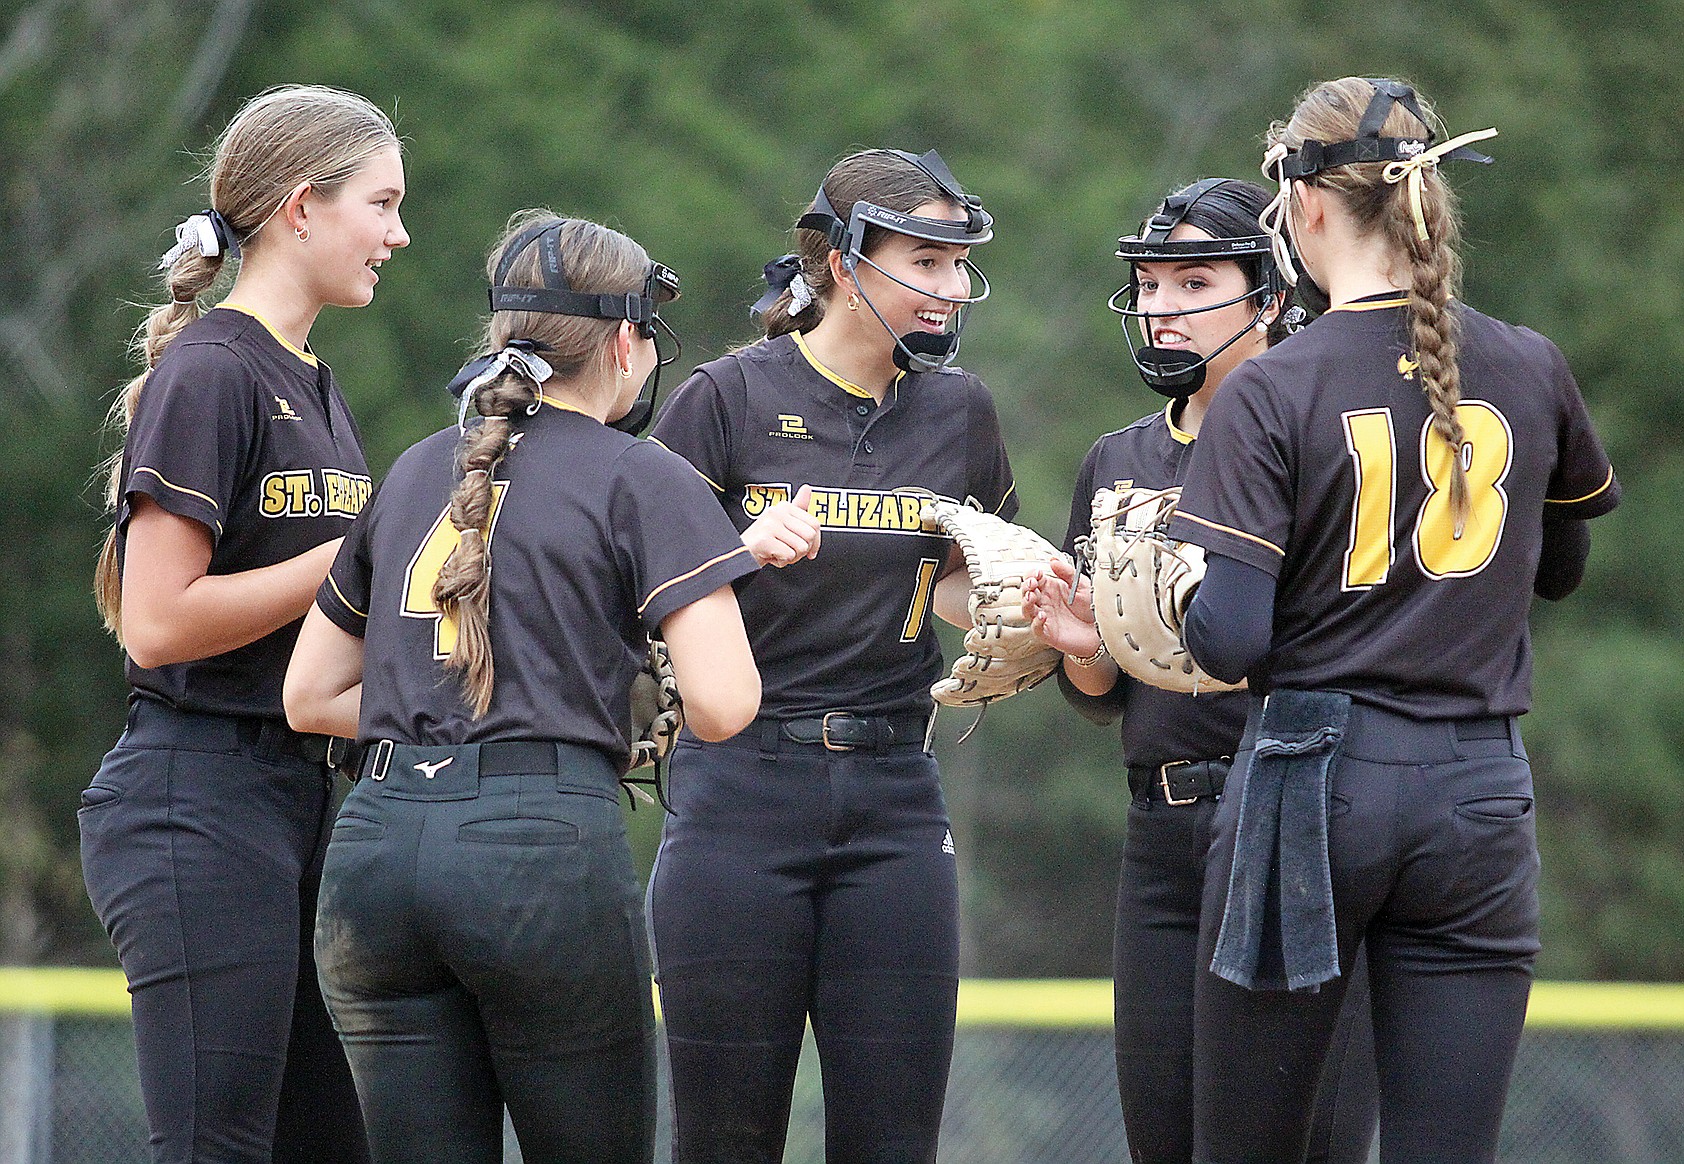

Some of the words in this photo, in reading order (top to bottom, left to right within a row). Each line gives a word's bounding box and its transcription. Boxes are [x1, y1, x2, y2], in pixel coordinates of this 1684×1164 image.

[877, 210, 907, 224] RIP-IT
[768, 431, 814, 440] PROLOOK
[259, 468, 323, 519] ST.
[805, 485, 958, 538] ELIZAB
[1341, 399, 1515, 592] 18
[399, 480, 511, 661] 4
[899, 557, 940, 643] 1
